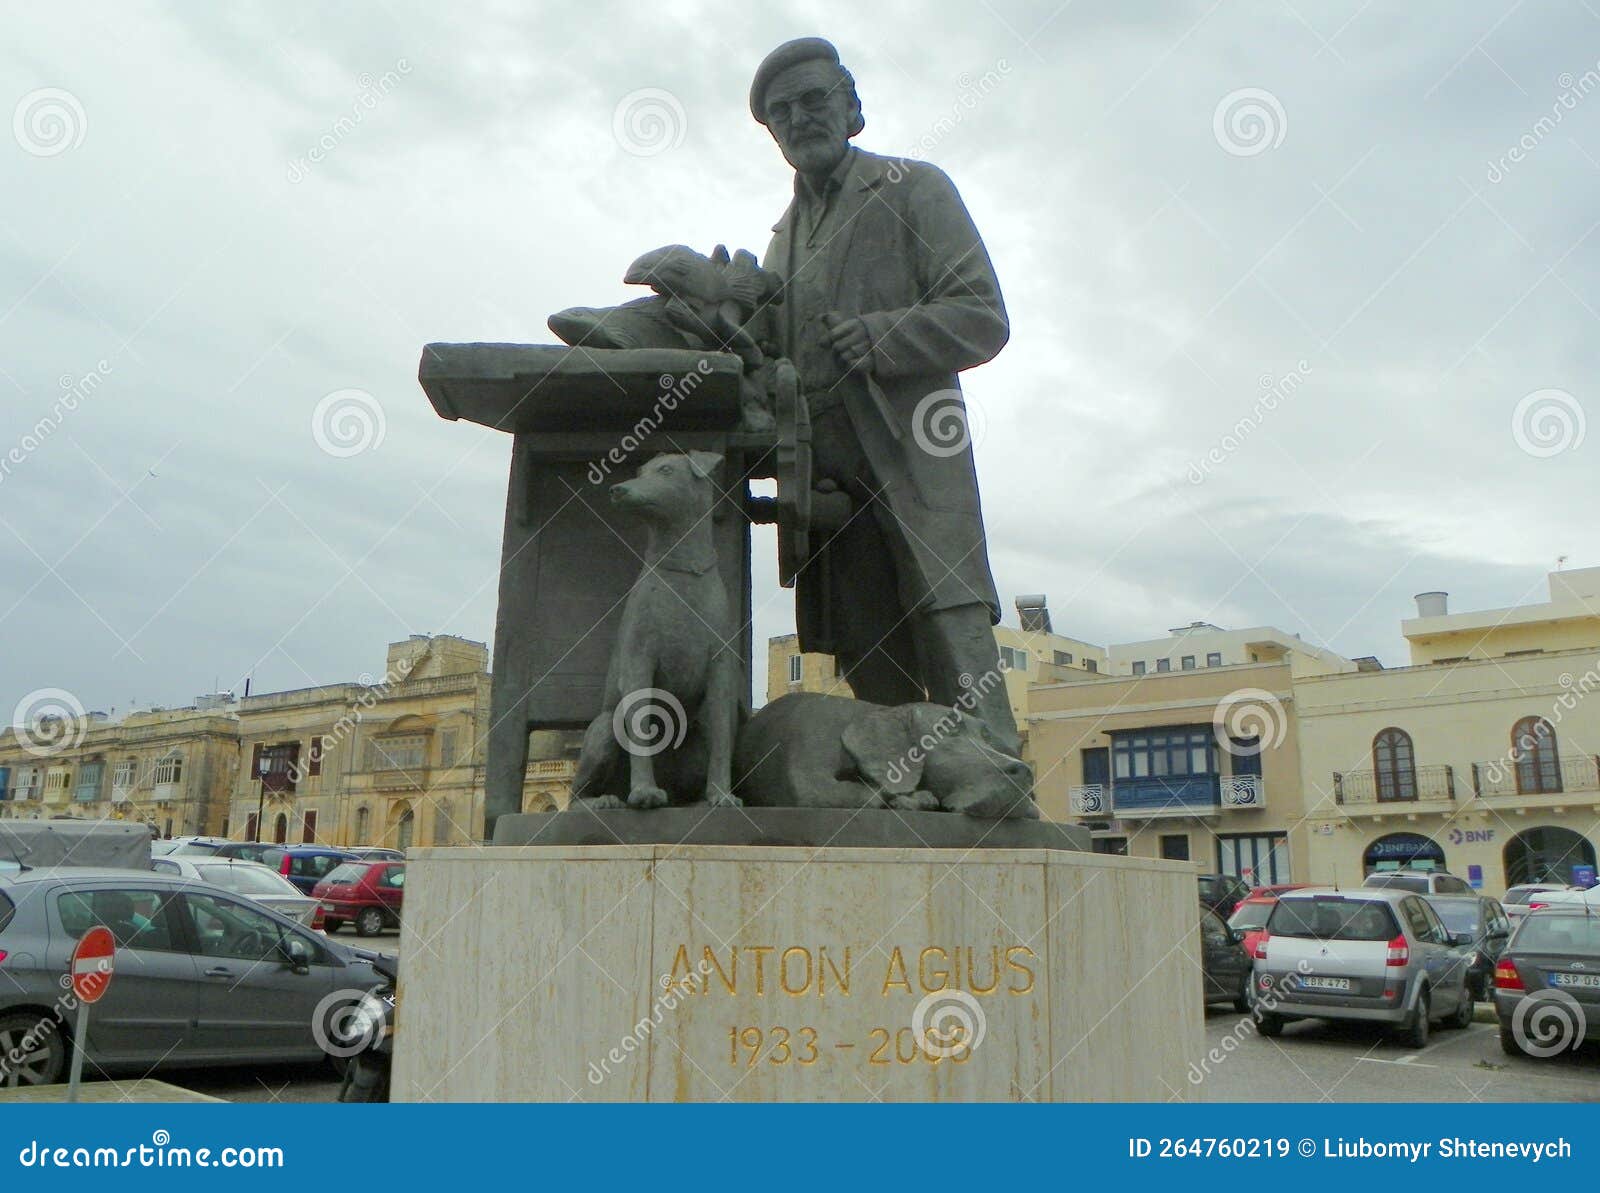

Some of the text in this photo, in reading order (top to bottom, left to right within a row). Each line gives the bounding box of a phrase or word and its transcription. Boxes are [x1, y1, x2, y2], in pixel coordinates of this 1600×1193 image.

[1465, 829, 1495, 841] BNF
[665, 944, 1036, 997] ANTON AGIUS
[1555, 974, 1581, 985] ESP
[728, 1026, 819, 1067] 1933
[869, 1026, 972, 1066] 2008
